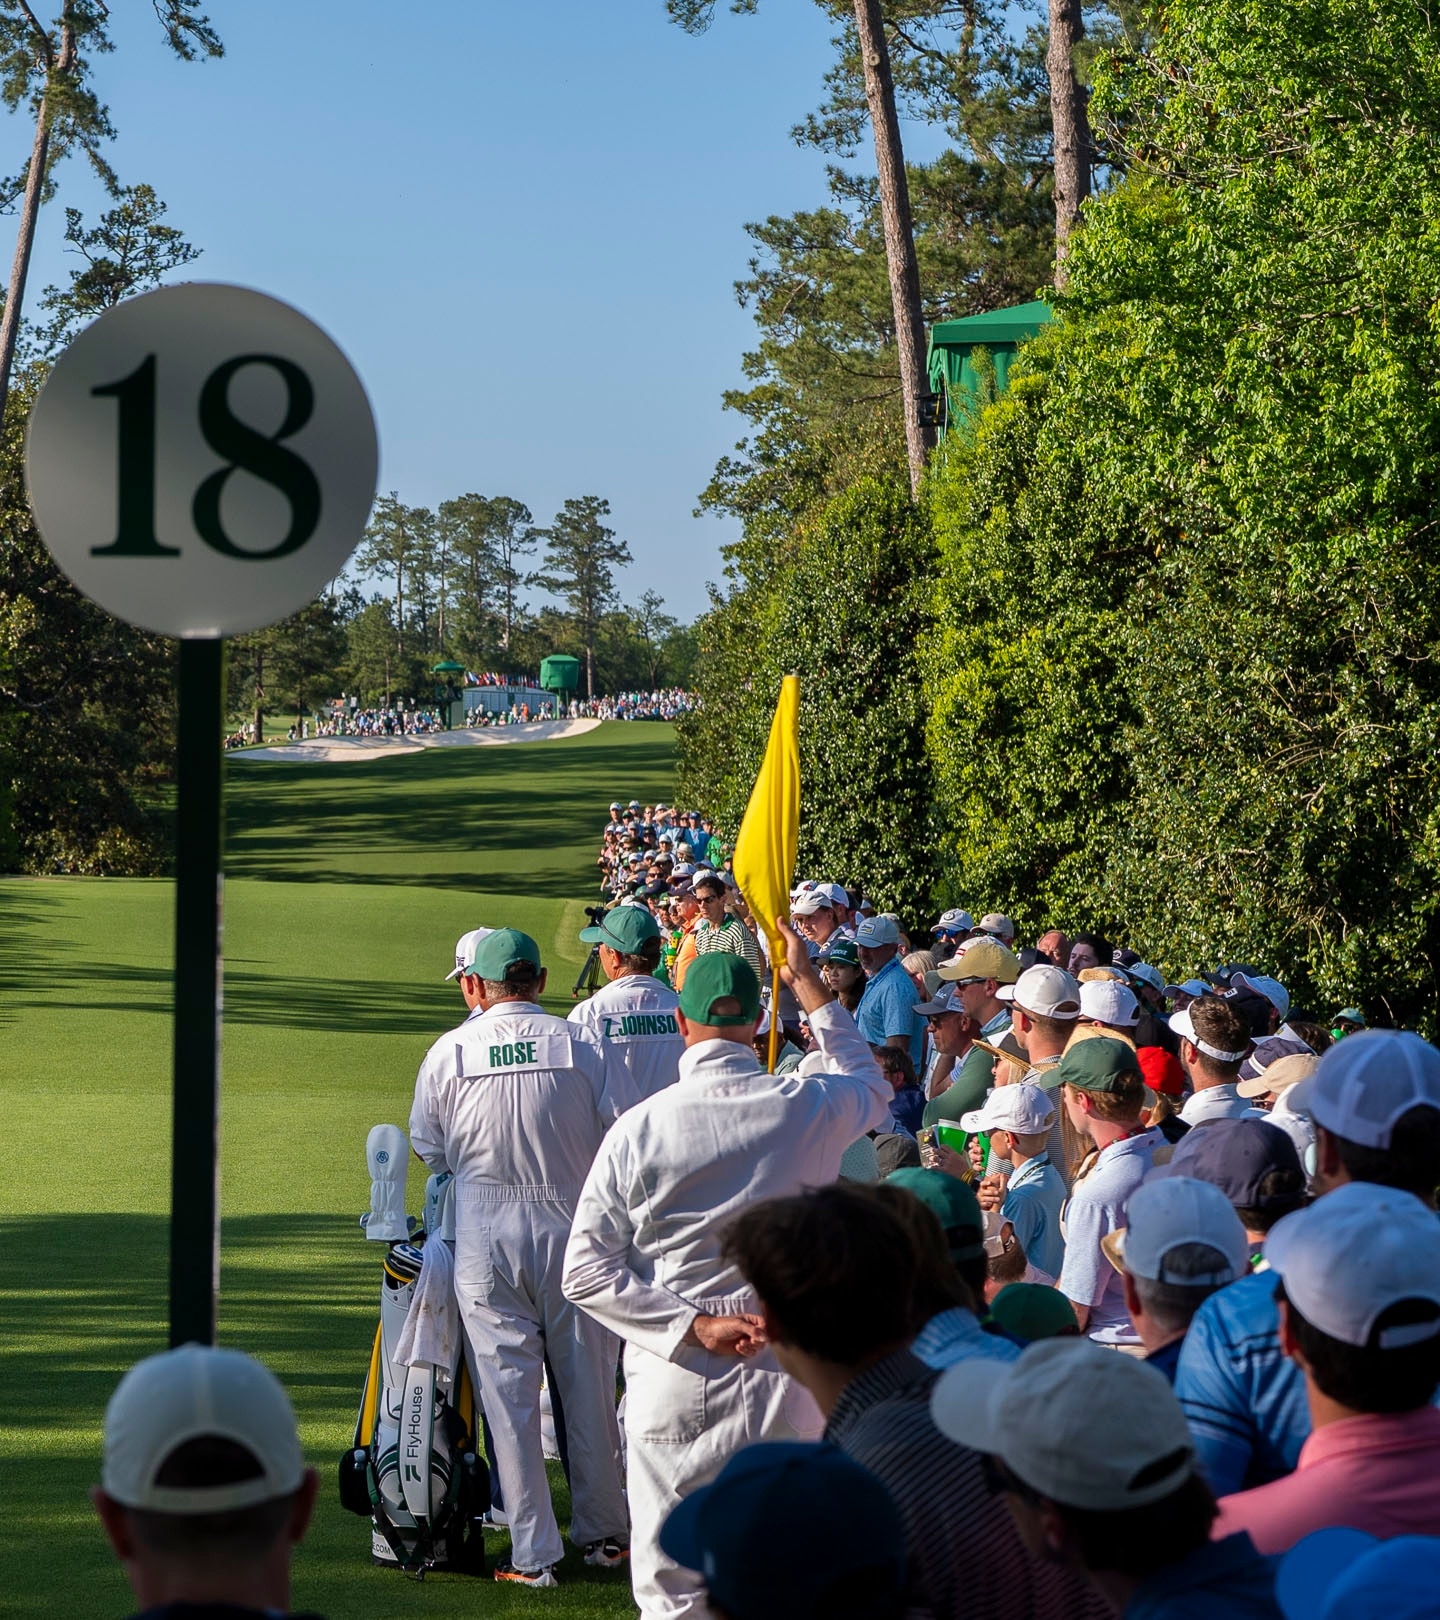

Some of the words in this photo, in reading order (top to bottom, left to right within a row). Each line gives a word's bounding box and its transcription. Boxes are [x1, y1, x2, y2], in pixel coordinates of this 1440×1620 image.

[90, 351, 323, 562] 18
[603, 1014, 680, 1038] Z.JOHNSO
[489, 1041, 538, 1068] ROSE
[406, 1386, 423, 1458] FlyHouse
